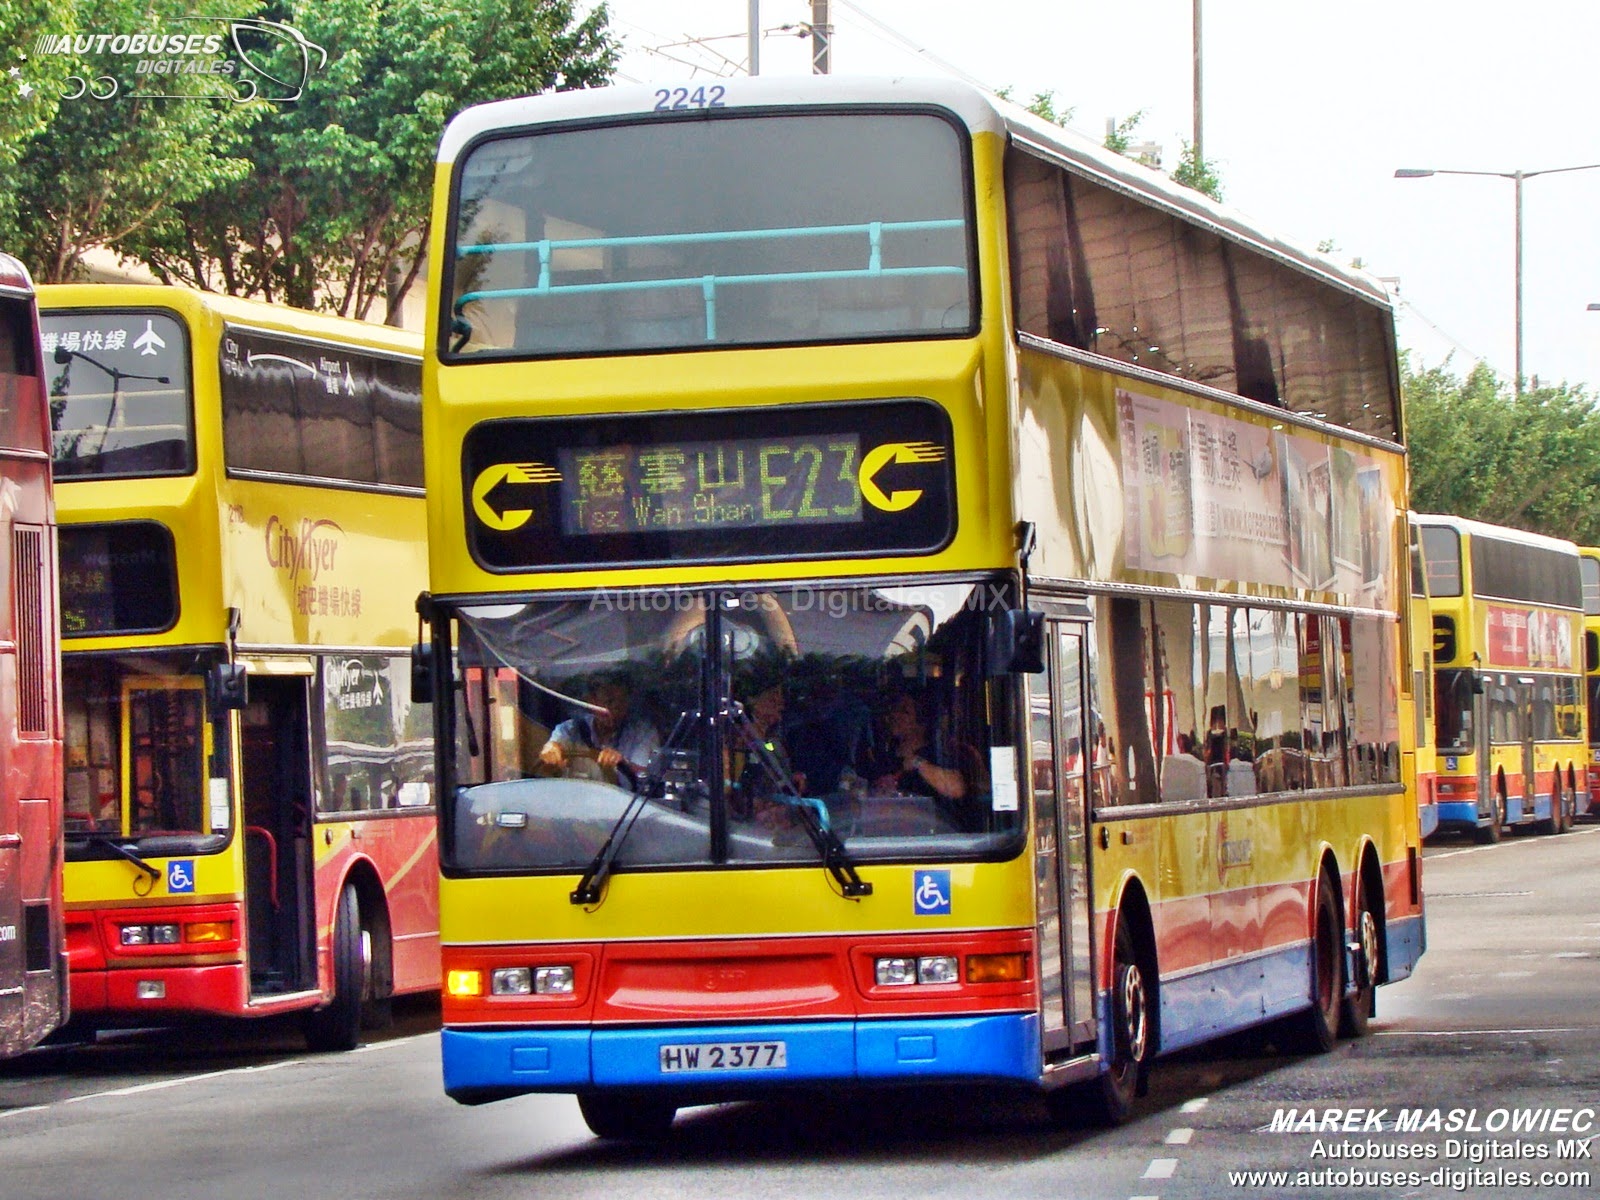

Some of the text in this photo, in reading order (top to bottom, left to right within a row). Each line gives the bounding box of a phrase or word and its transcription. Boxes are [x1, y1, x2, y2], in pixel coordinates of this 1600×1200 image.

[654, 85, 726, 111] 2242
[760, 442, 861, 519] E23
[572, 493, 754, 528] Tsz Wan Shan
[664, 1045, 778, 1069] HW 2377
